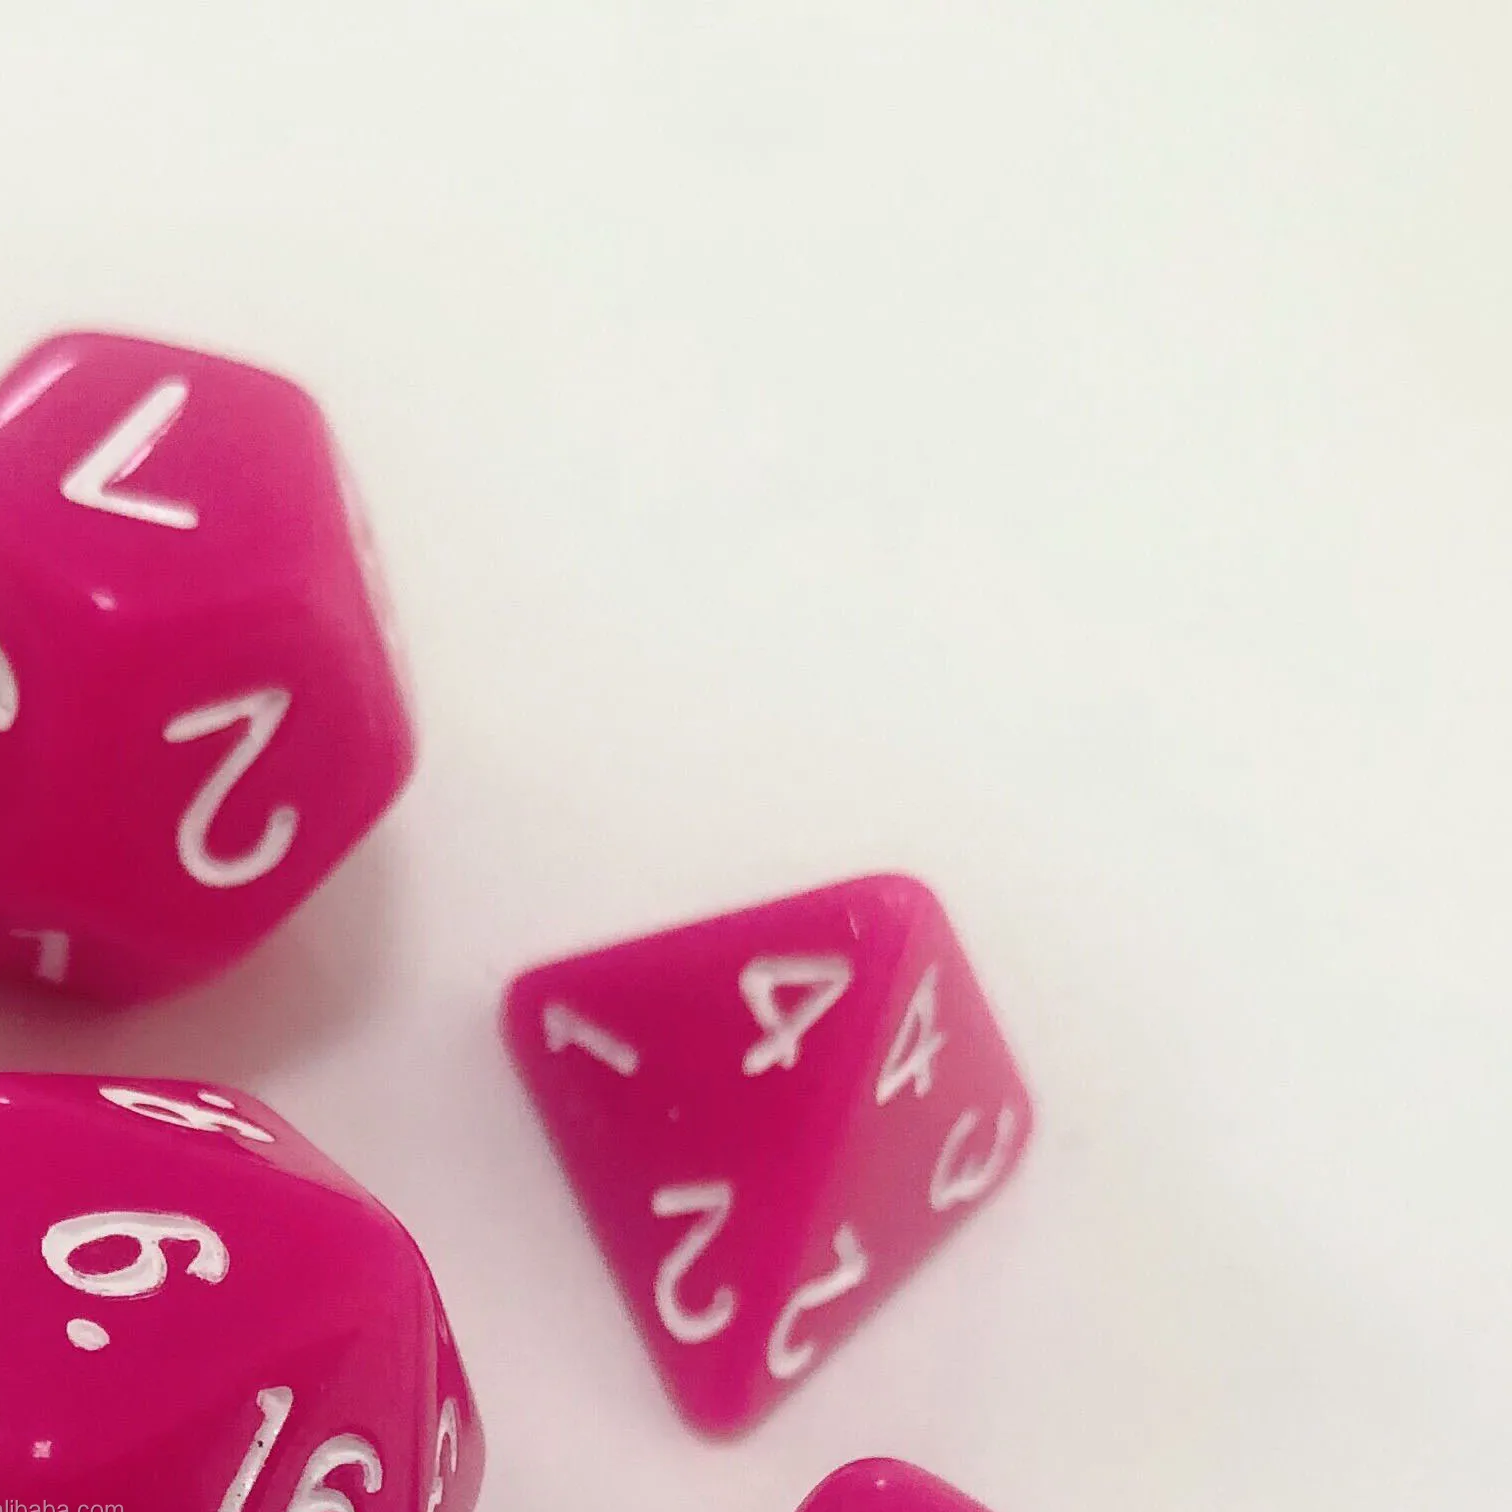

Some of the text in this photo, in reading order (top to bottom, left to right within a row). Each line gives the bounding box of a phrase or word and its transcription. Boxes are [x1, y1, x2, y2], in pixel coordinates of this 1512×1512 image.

[61, 376, 197, 528] 7
[163, 688, 297, 887] 2
[543, 1003, 638, 1076] 1
[739, 956, 853, 1075] 4
[876, 963, 947, 1105] 4
[930, 1107, 1018, 1212] 3
[652, 1183, 736, 1343] 2
[767, 1223, 868, 1379] 2
